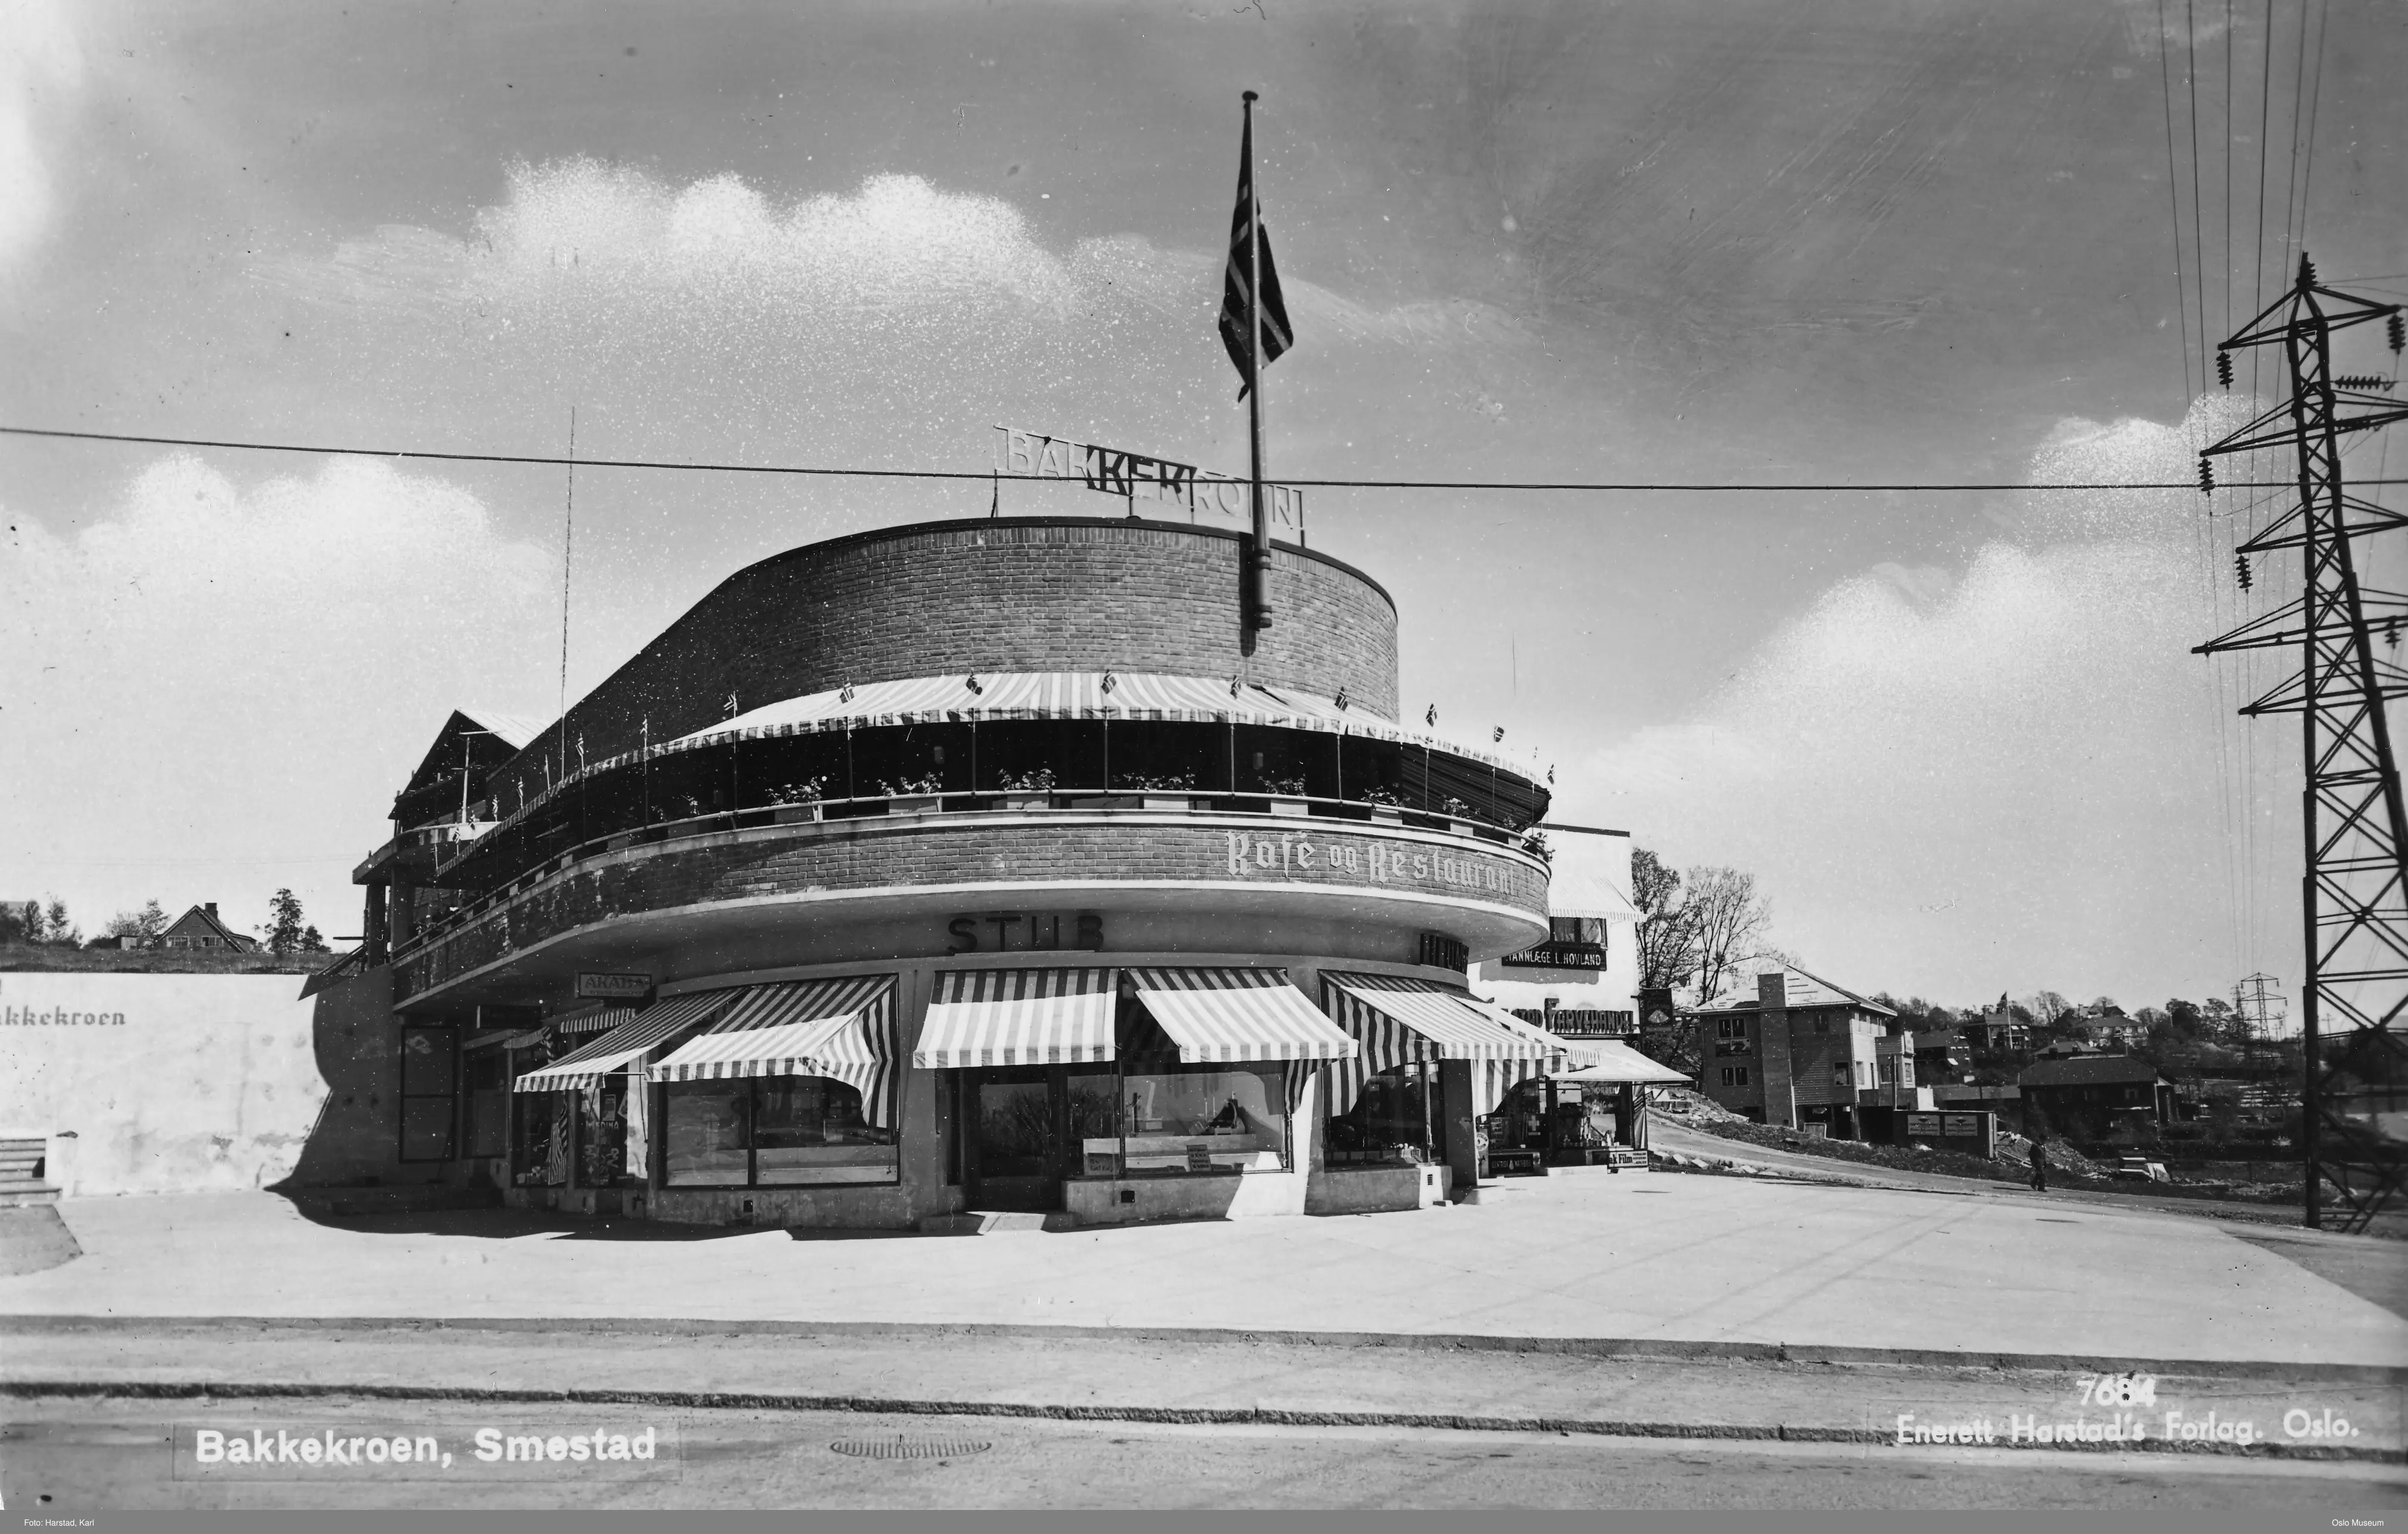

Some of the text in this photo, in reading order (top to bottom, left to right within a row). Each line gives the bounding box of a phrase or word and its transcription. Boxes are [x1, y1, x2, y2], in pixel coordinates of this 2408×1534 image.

[999, 427, 1300, 526] BAKKEKRON
[1329, 845, 1358, 874] og
[1367, 841, 1515, 895] Restaurant
[947, 915, 1105, 953] STUB
[0, 1004, 126, 1025] kkekroen
[1618, 1153, 1633, 1164] Film
